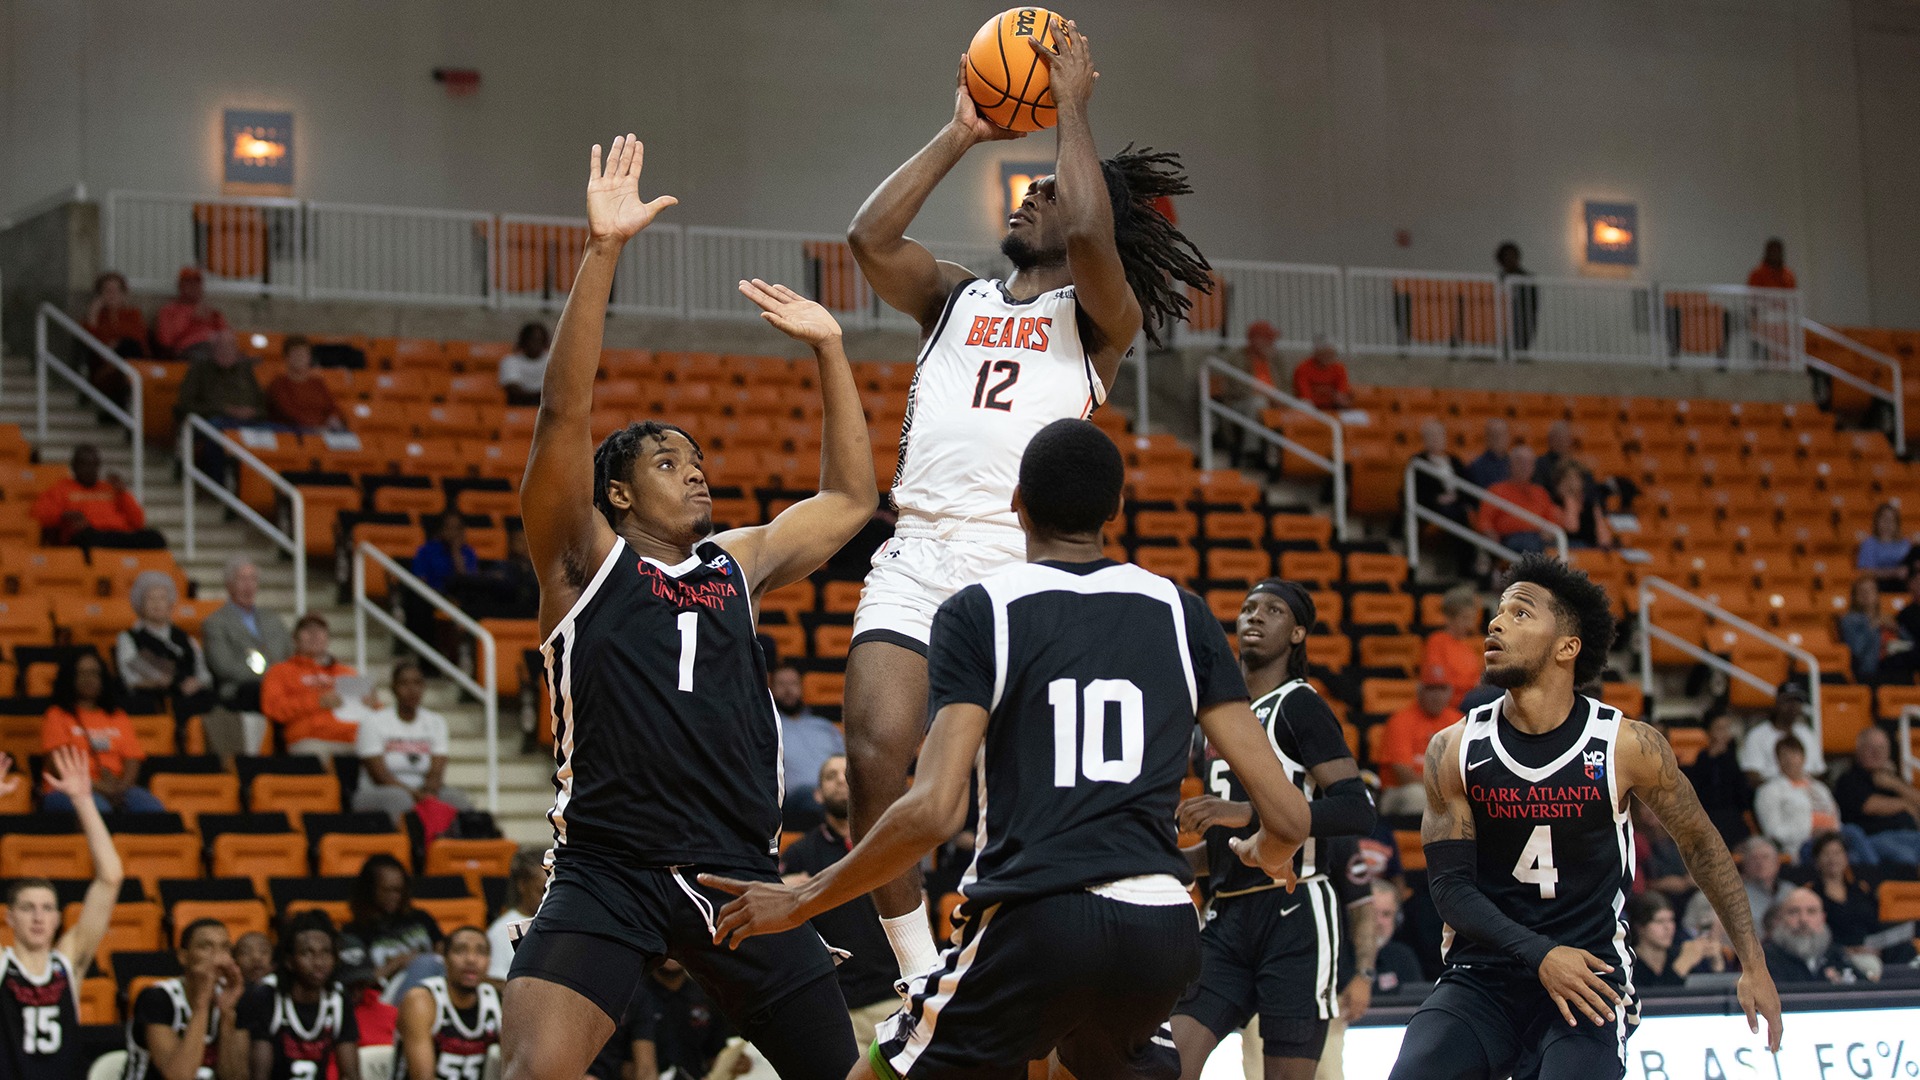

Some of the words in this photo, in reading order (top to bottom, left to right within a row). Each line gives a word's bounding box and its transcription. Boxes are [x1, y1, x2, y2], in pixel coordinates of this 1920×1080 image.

[1016, 10, 1037, 36] CAA
[965, 315, 1052, 352] BEARS
[971, 360, 1021, 412] 12
[677, 611, 698, 692] 1
[1048, 678, 1144, 787] 10
[1471, 785, 1520, 801] CLARK
[1527, 785, 1601, 801] ATLANTA
[1487, 803, 1584, 819] UNIVERSITY
[1512, 825, 1559, 899] 4
[22, 1005, 62, 1054] 15
[1704, 1047, 1783, 1080] AST
[1815, 1040, 1919, 1080] FG%
